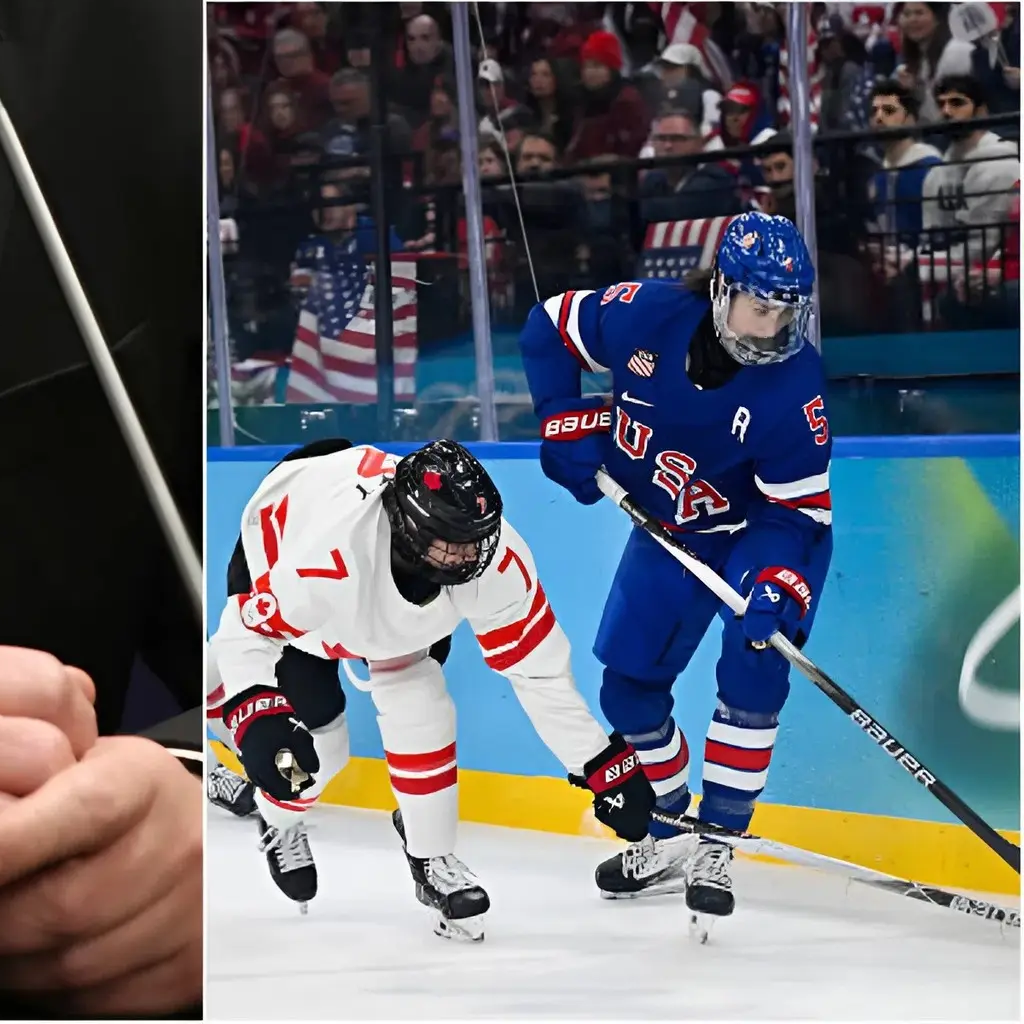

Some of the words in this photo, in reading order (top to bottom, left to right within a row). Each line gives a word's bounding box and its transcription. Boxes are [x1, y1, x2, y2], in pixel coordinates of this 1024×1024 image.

[802, 395, 828, 445] 5
[613, 404, 730, 524] USA
[296, 548, 349, 580] 7
[497, 546, 532, 593] 7
